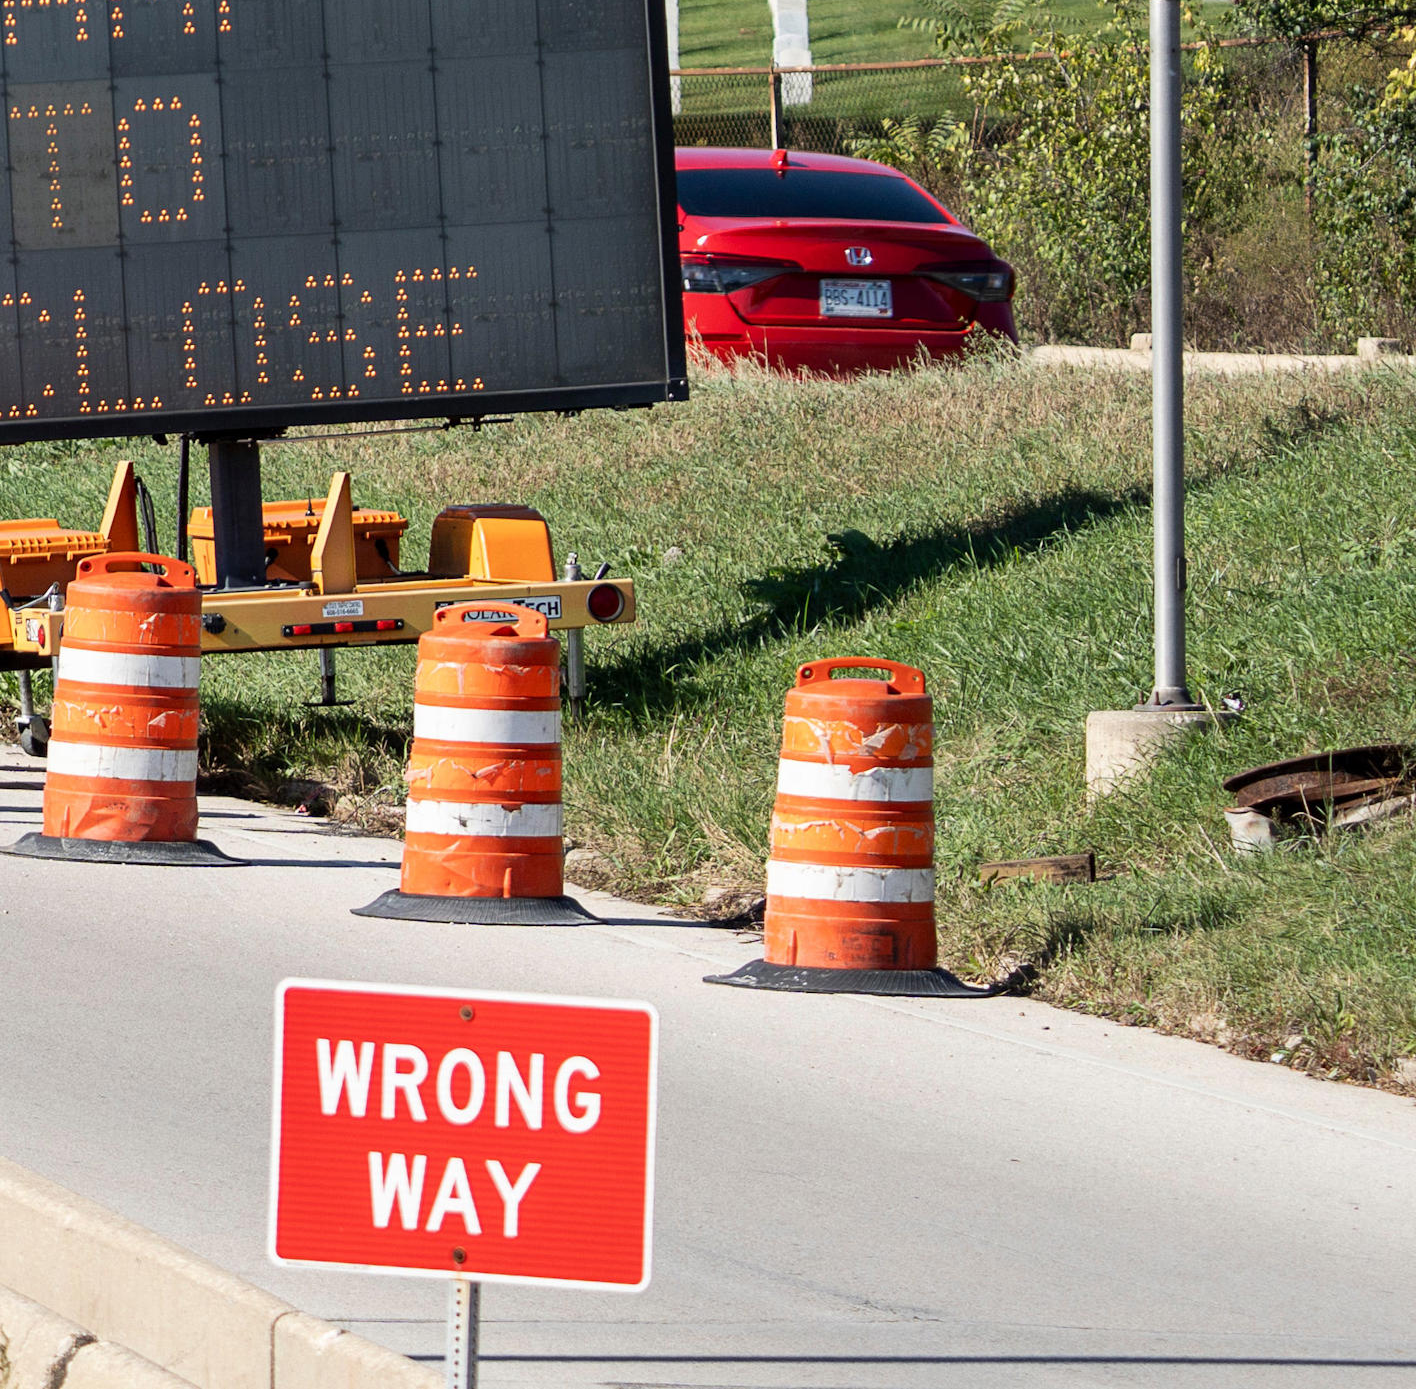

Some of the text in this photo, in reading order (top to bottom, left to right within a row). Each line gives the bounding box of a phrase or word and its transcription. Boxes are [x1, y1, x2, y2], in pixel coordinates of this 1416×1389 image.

[10, 96, 206, 228] TO
[824, 288, 888, 307] BBS-4114
[316, 1038, 601, 1134] WRONG
[368, 1150, 542, 1239] WAY
